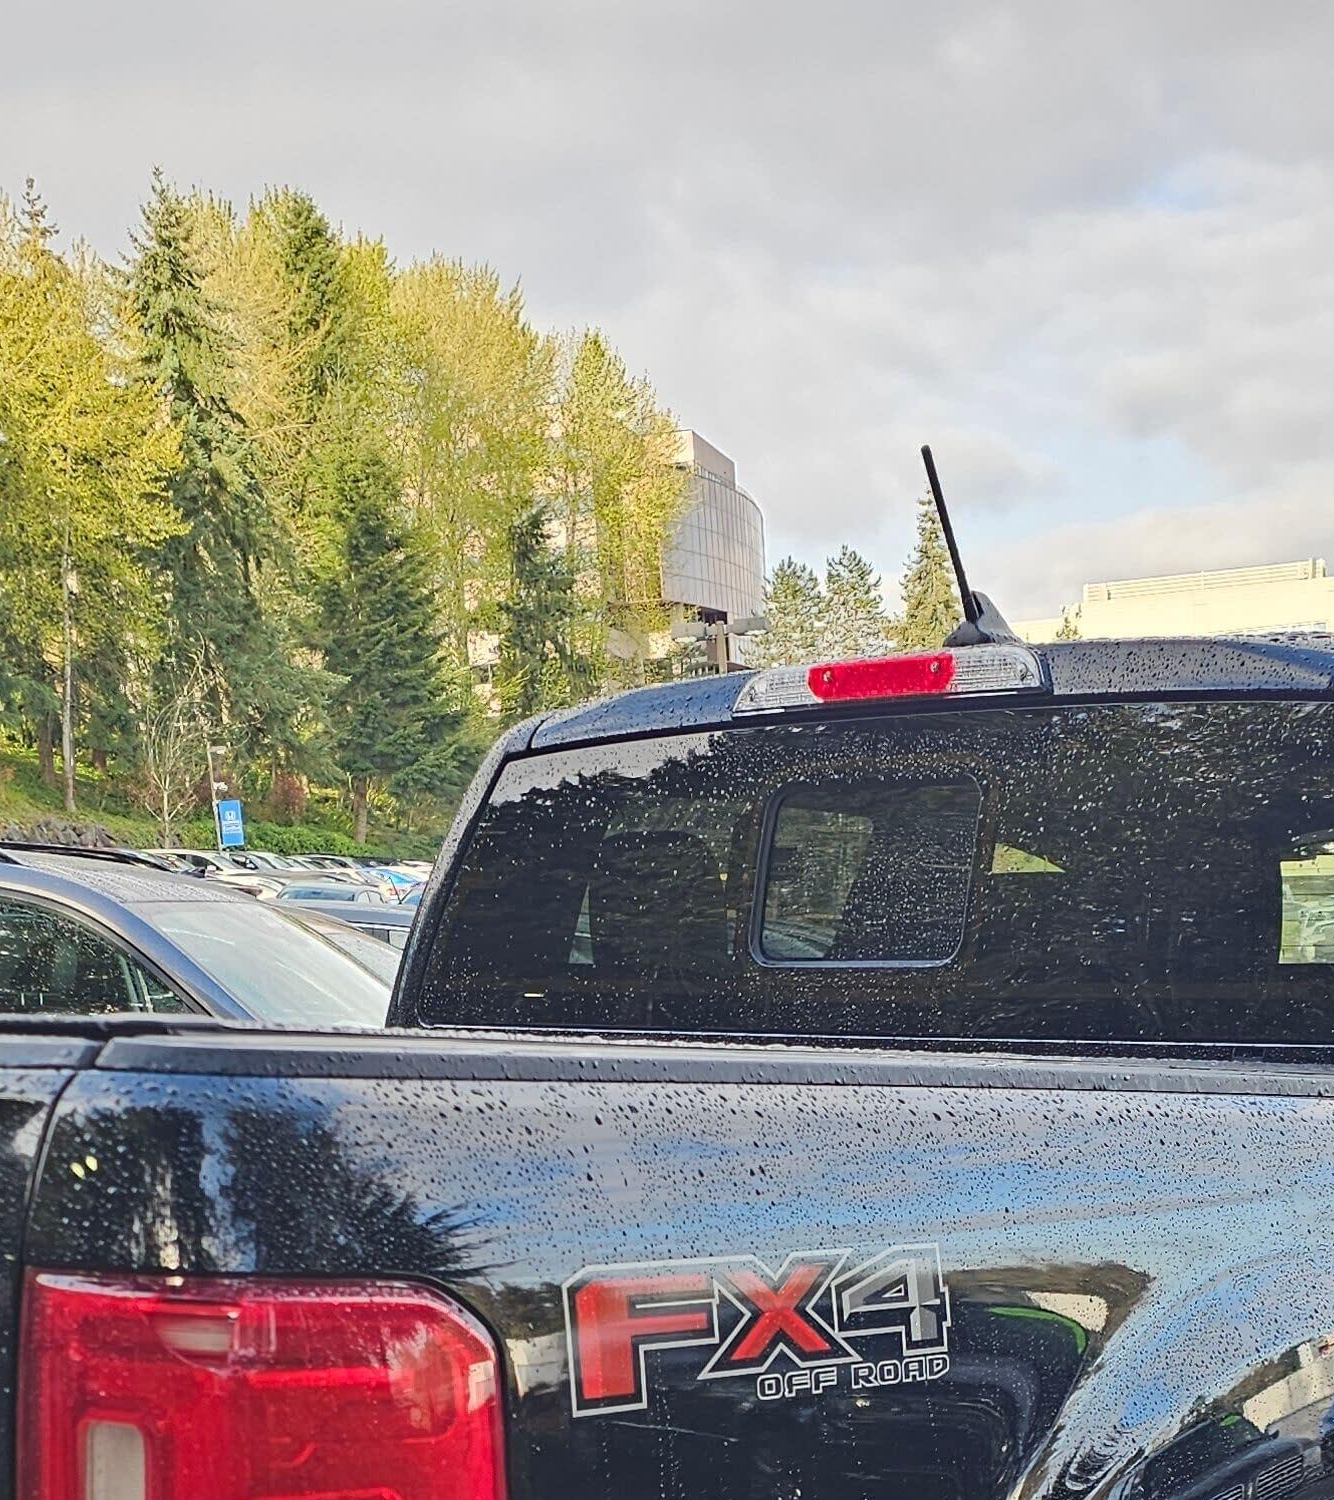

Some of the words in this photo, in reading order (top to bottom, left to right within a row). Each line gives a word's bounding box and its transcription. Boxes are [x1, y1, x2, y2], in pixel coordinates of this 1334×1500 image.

[563, 1242, 952, 1418] FX4
[756, 1368, 838, 1401] OFF
[851, 1354, 950, 1389] ROAD
